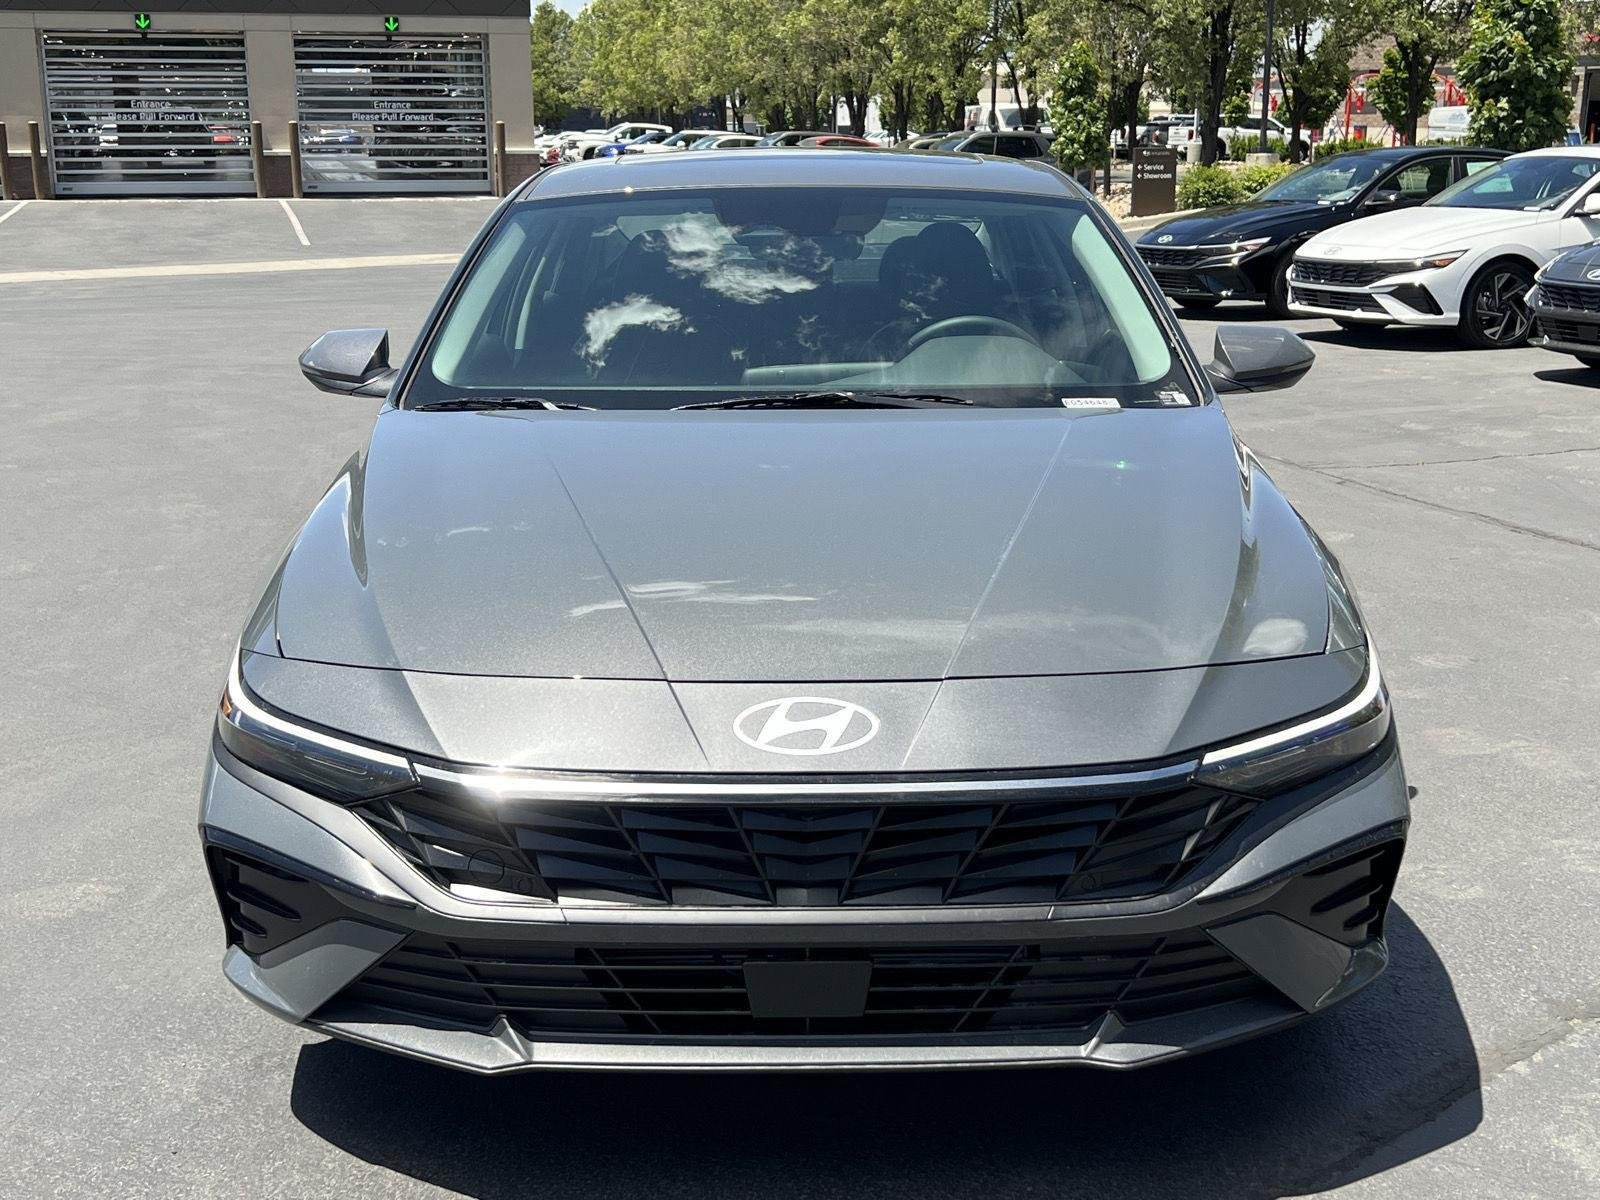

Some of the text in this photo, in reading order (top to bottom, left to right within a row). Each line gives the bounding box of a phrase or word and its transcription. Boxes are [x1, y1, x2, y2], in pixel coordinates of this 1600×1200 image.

[131, 100, 169, 108] Entrance
[374, 101, 411, 109] Entrance
[108, 112, 194, 121] Please Pull Forward
[352, 112, 434, 121] Please Pull Forward
